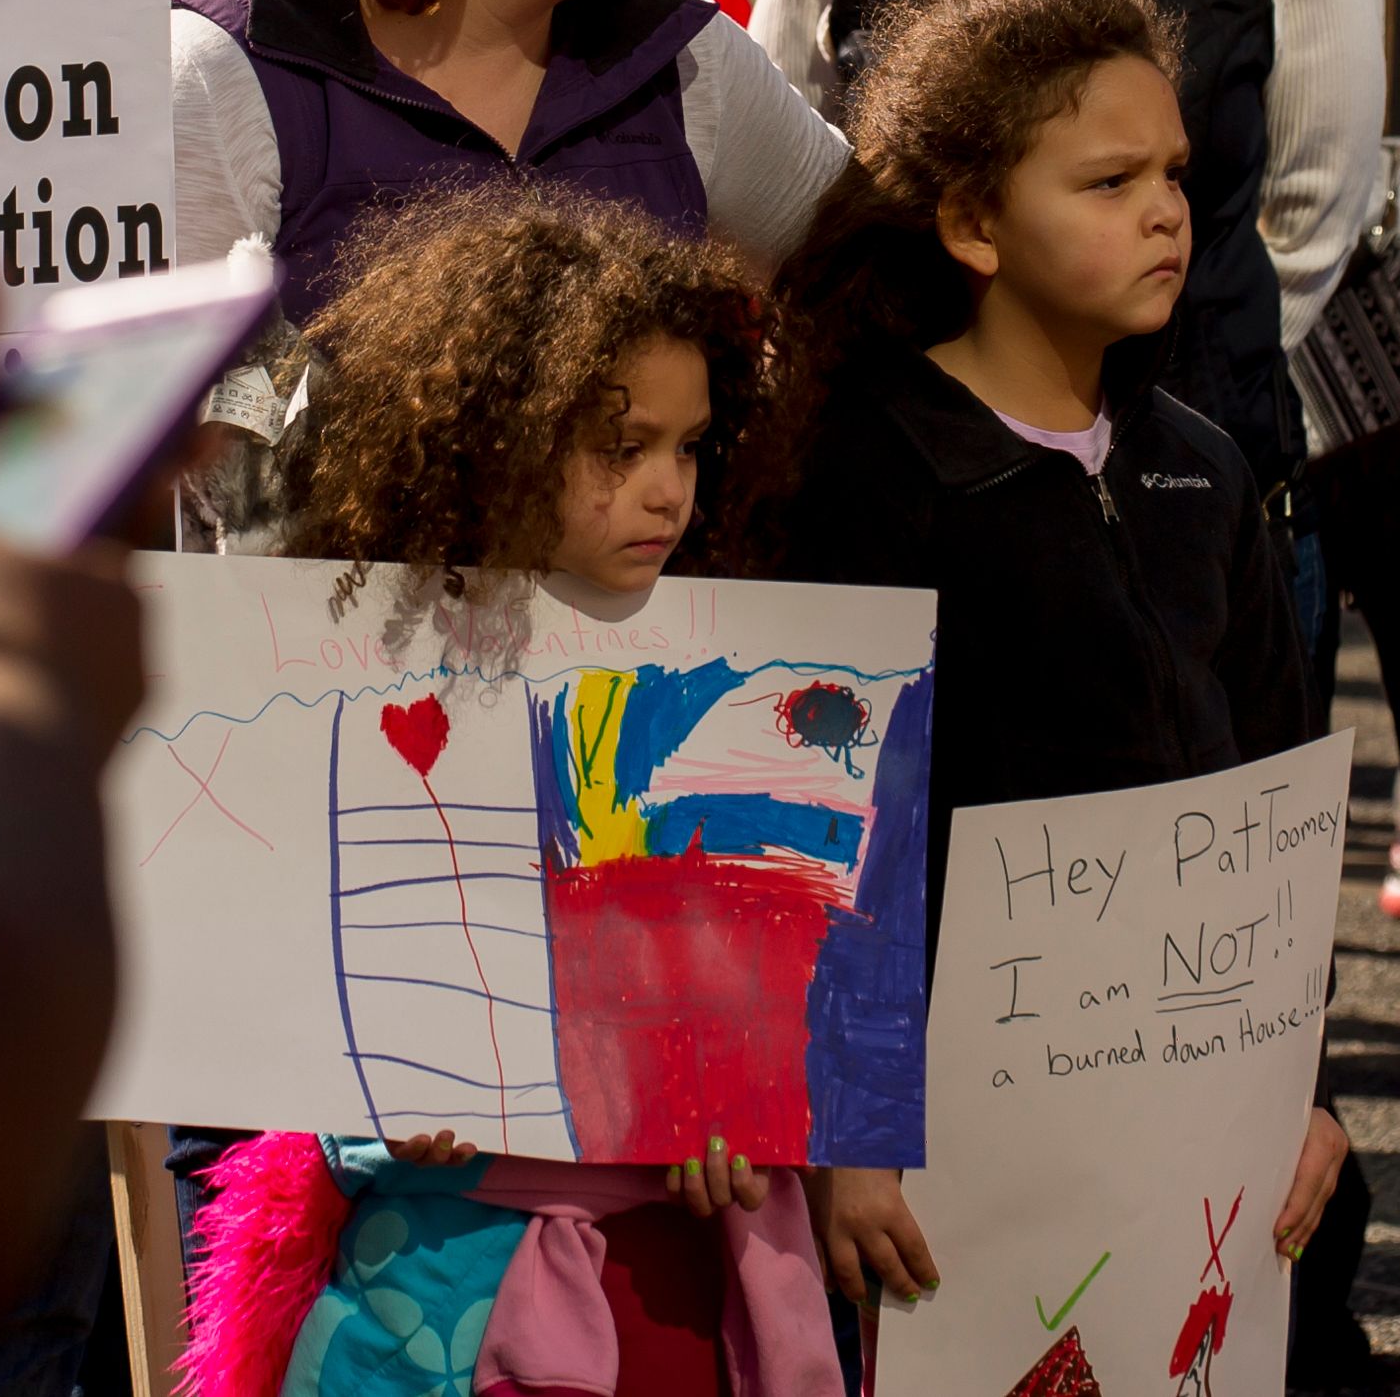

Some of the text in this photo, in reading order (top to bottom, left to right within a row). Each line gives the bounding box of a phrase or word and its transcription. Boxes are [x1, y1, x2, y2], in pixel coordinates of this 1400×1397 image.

[995, 824, 1126, 922] Hey
[990, 956, 1042, 1023] I
[1080, 983, 1129, 1009] am
[992, 1069, 1014, 1088] a
[1047, 1029, 1145, 1076] burned
[1163, 1025, 1225, 1064] down
